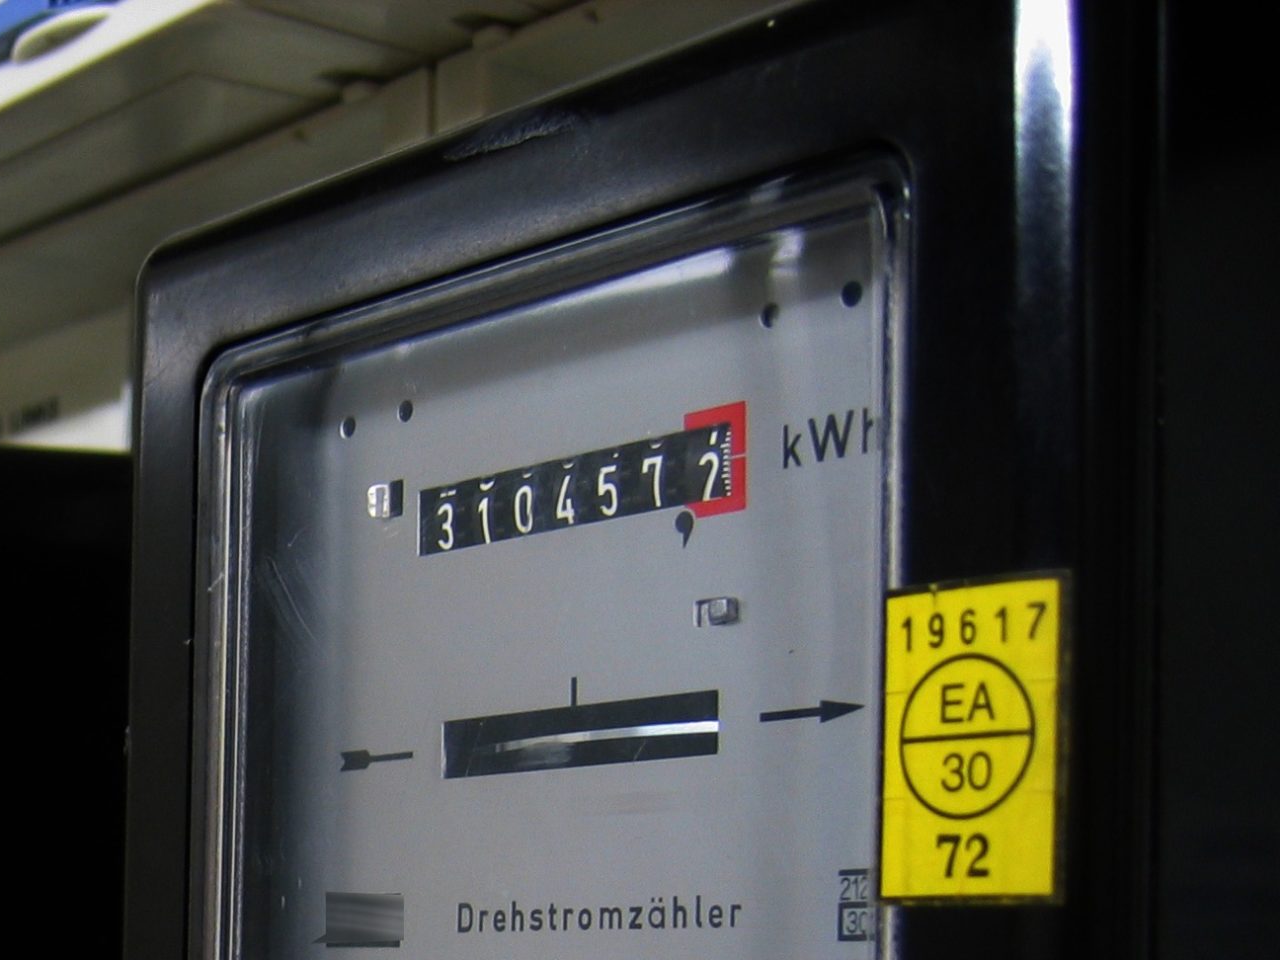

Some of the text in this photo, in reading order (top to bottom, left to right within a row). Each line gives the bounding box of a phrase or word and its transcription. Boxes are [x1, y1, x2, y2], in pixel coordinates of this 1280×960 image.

[783, 407, 874, 469] kWh
[901, 602, 1047, 652] 19617
[940, 682, 995, 723] EA
[941, 752, 992, 792] 30
[936, 834, 990, 878] 72
[457, 897, 742, 933] Drehstromzähler
